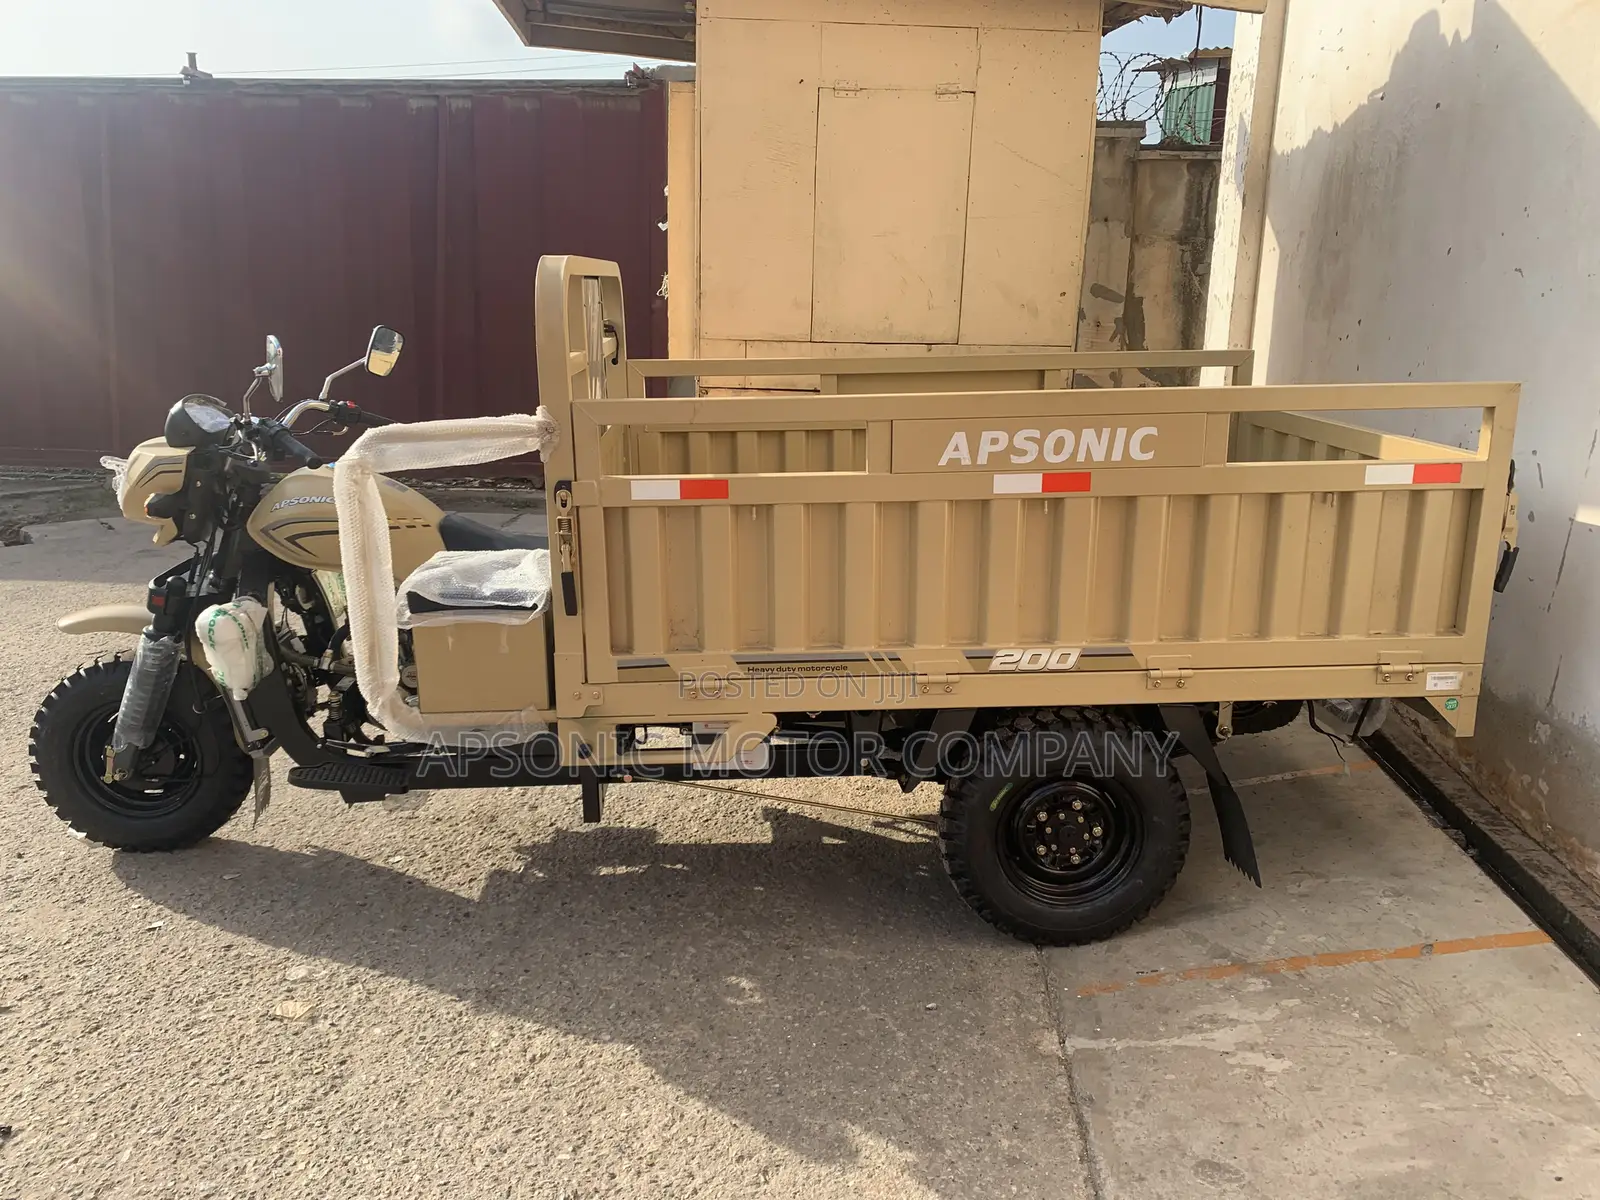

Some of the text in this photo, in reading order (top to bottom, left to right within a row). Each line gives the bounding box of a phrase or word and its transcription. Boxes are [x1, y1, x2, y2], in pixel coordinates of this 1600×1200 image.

[938, 426, 1158, 466] APSONIC
[270, 496, 335, 512] APSONIC
[747, 664, 848, 674] Heavy duty motorcycle
[989, 647, 1083, 672] 200
